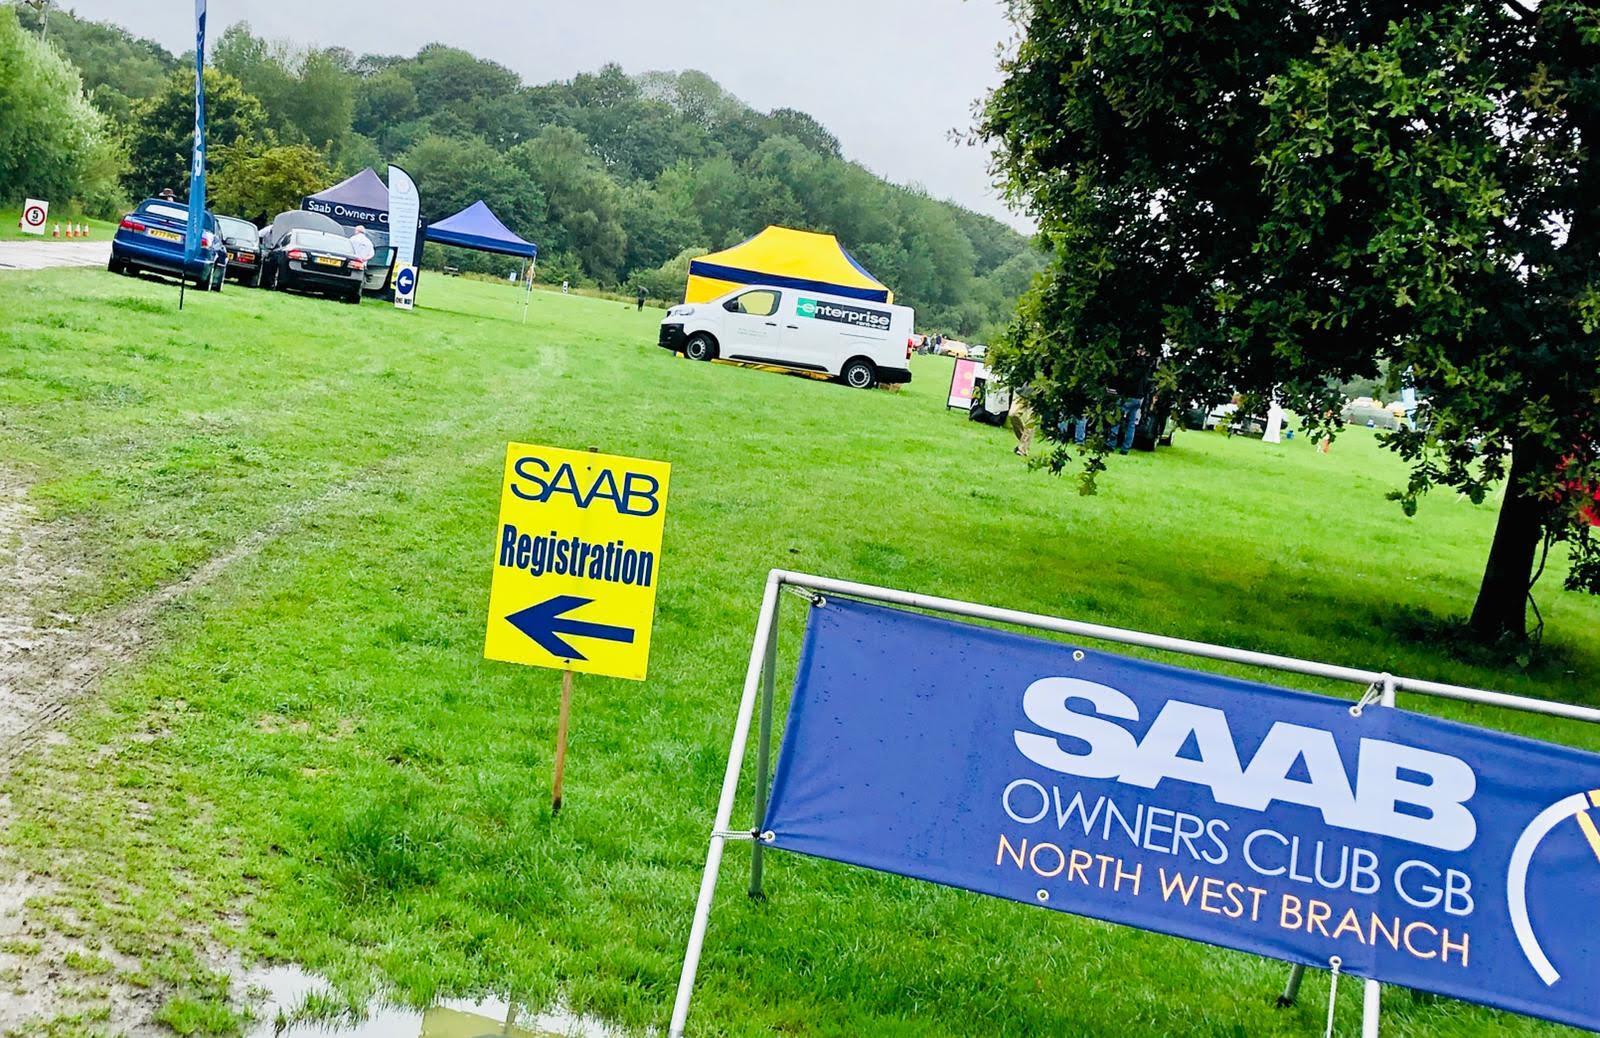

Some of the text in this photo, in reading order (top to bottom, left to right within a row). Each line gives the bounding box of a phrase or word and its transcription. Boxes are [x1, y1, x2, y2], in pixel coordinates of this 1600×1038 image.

[32, 210, 39, 220] 5
[308, 200, 331, 214] Saab
[334, 205, 376, 222] Owners
[799, 303, 890, 325] enterprise
[510, 456, 660, 517] SAAB
[499, 523, 654, 587] Registration
[1013, 676, 1477, 852] SAAB
[1002, 778, 1475, 916] OWNERS CLUB GB
[996, 834, 1469, 967] NORTH WEST BRANCH
